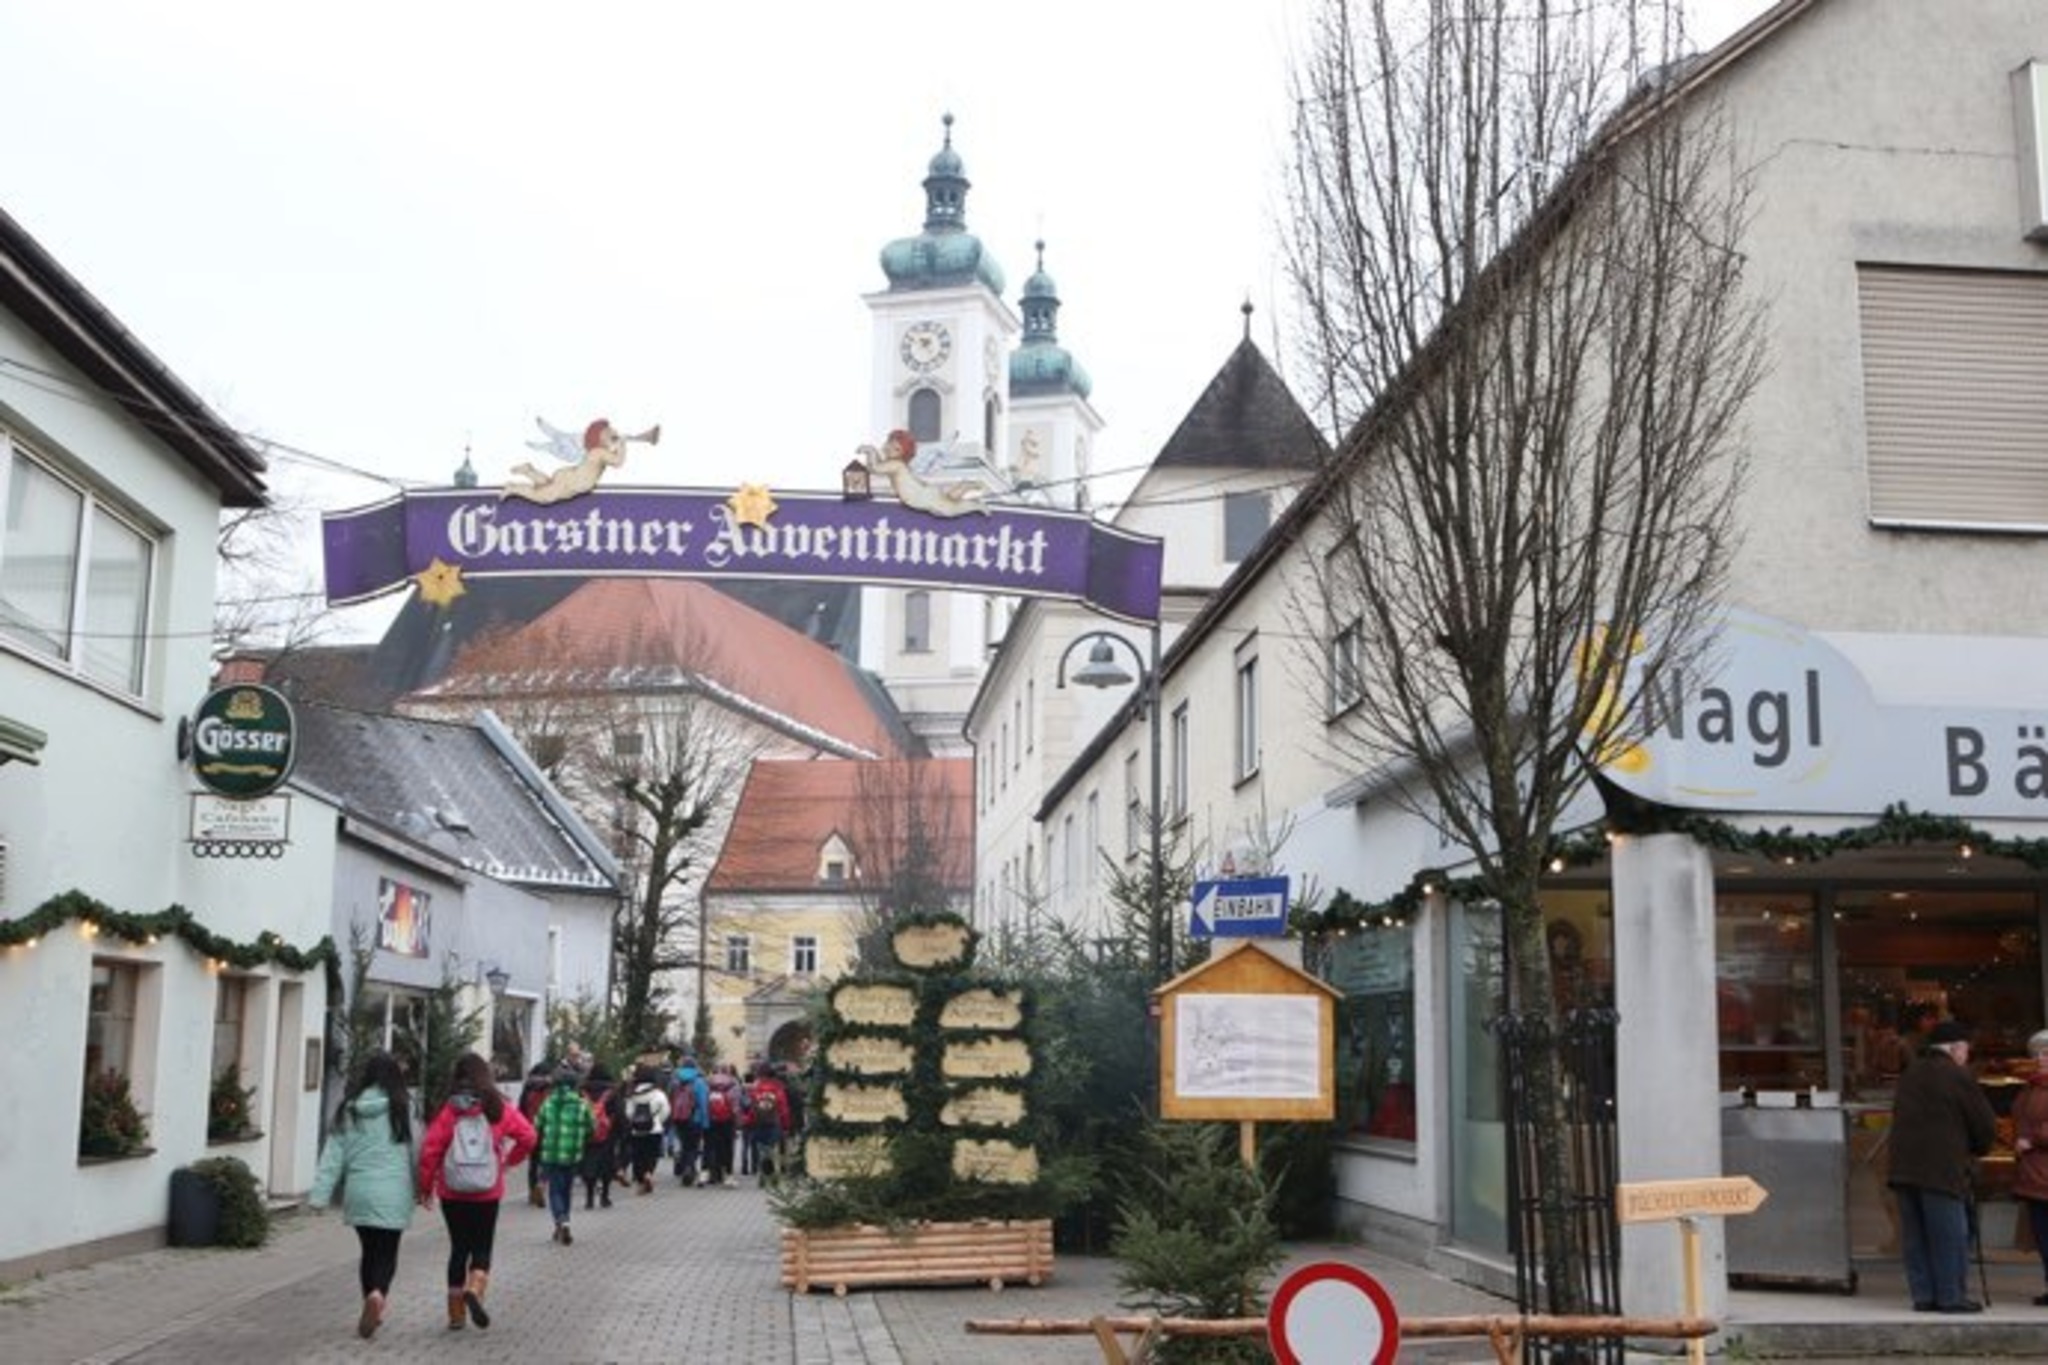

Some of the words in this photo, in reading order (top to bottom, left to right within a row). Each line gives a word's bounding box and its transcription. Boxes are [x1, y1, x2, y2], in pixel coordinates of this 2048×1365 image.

[447, 503, 693, 557] Garstner
[704, 504, 1048, 575] Adventmarkt
[197, 715, 287, 758] Gösser
[1641, 666, 1823, 768] Nagl
[1945, 724, 2048, 800] Bä
[1214, 897, 1275, 918] EINBAHN
